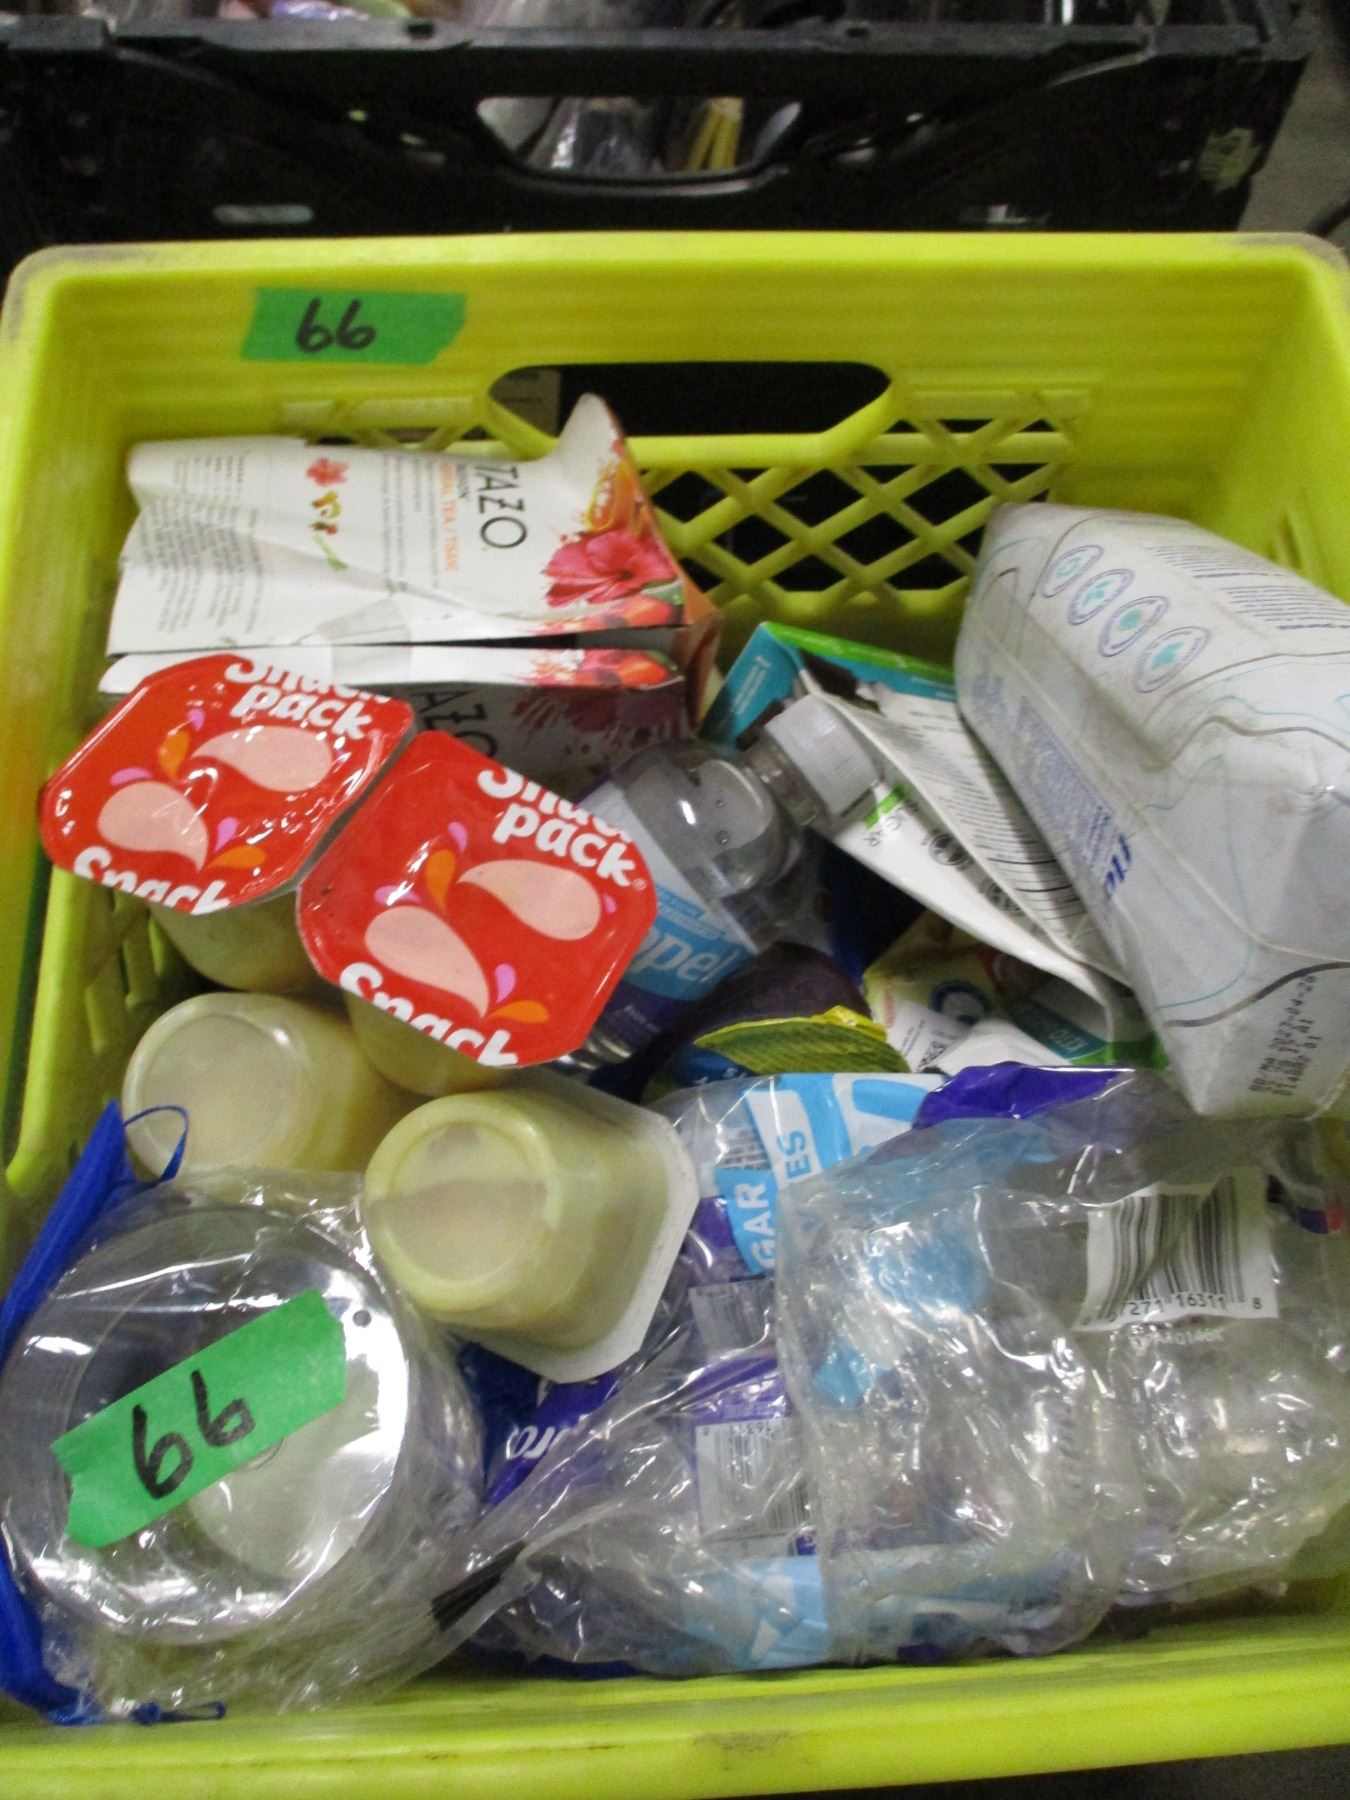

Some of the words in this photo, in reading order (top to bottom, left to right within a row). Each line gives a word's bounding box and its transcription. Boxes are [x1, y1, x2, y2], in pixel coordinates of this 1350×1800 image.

[296, 296, 377, 353] 66
[474, 464, 528, 549] TAZO
[410, 687, 498, 758] AZO
[776, 1129, 813, 1180] ES
[132, 1369, 256, 1500] 66
